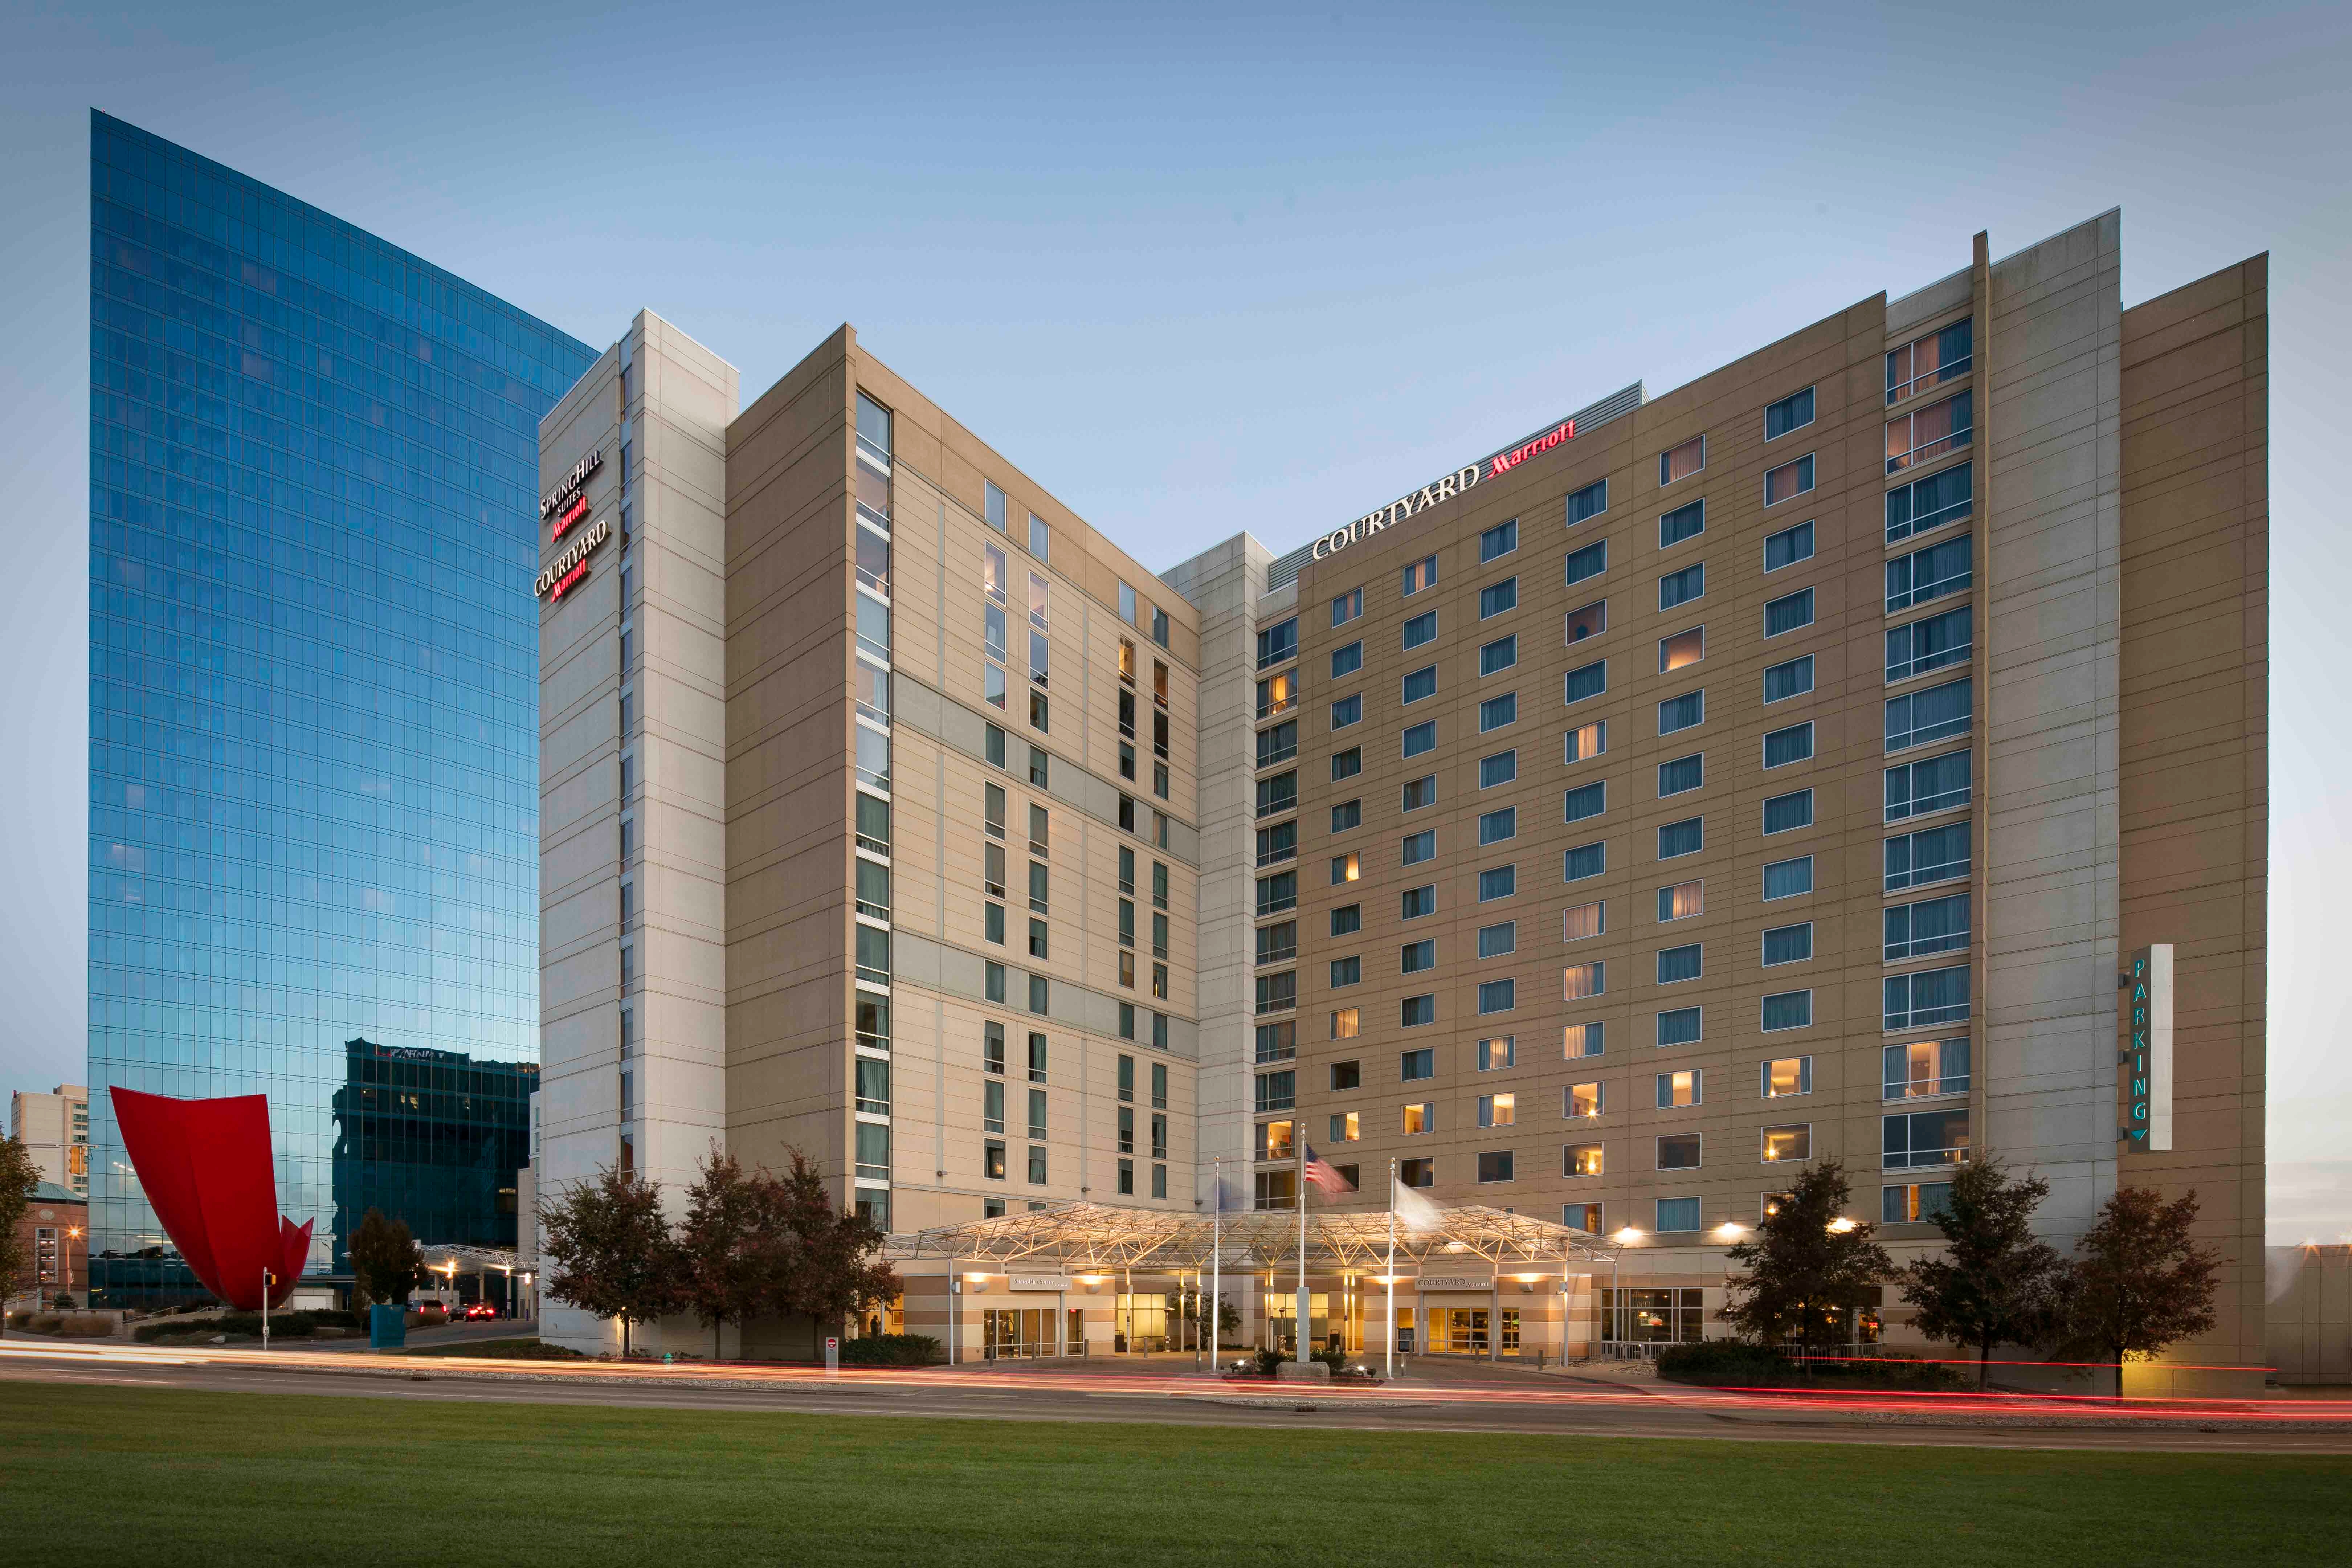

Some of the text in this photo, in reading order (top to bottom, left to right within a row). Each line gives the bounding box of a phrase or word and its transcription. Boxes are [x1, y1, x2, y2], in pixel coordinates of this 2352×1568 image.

[551, 496, 587, 543] Marriott
[558, 487, 581, 517] SUITES
[1312, 420, 1576, 560] COURTYARD Marriott
[534, 520, 608, 597] COURTYARD
[551, 558, 587, 603] Marriott
[2133, 959, 2146, 1120] PARKING
